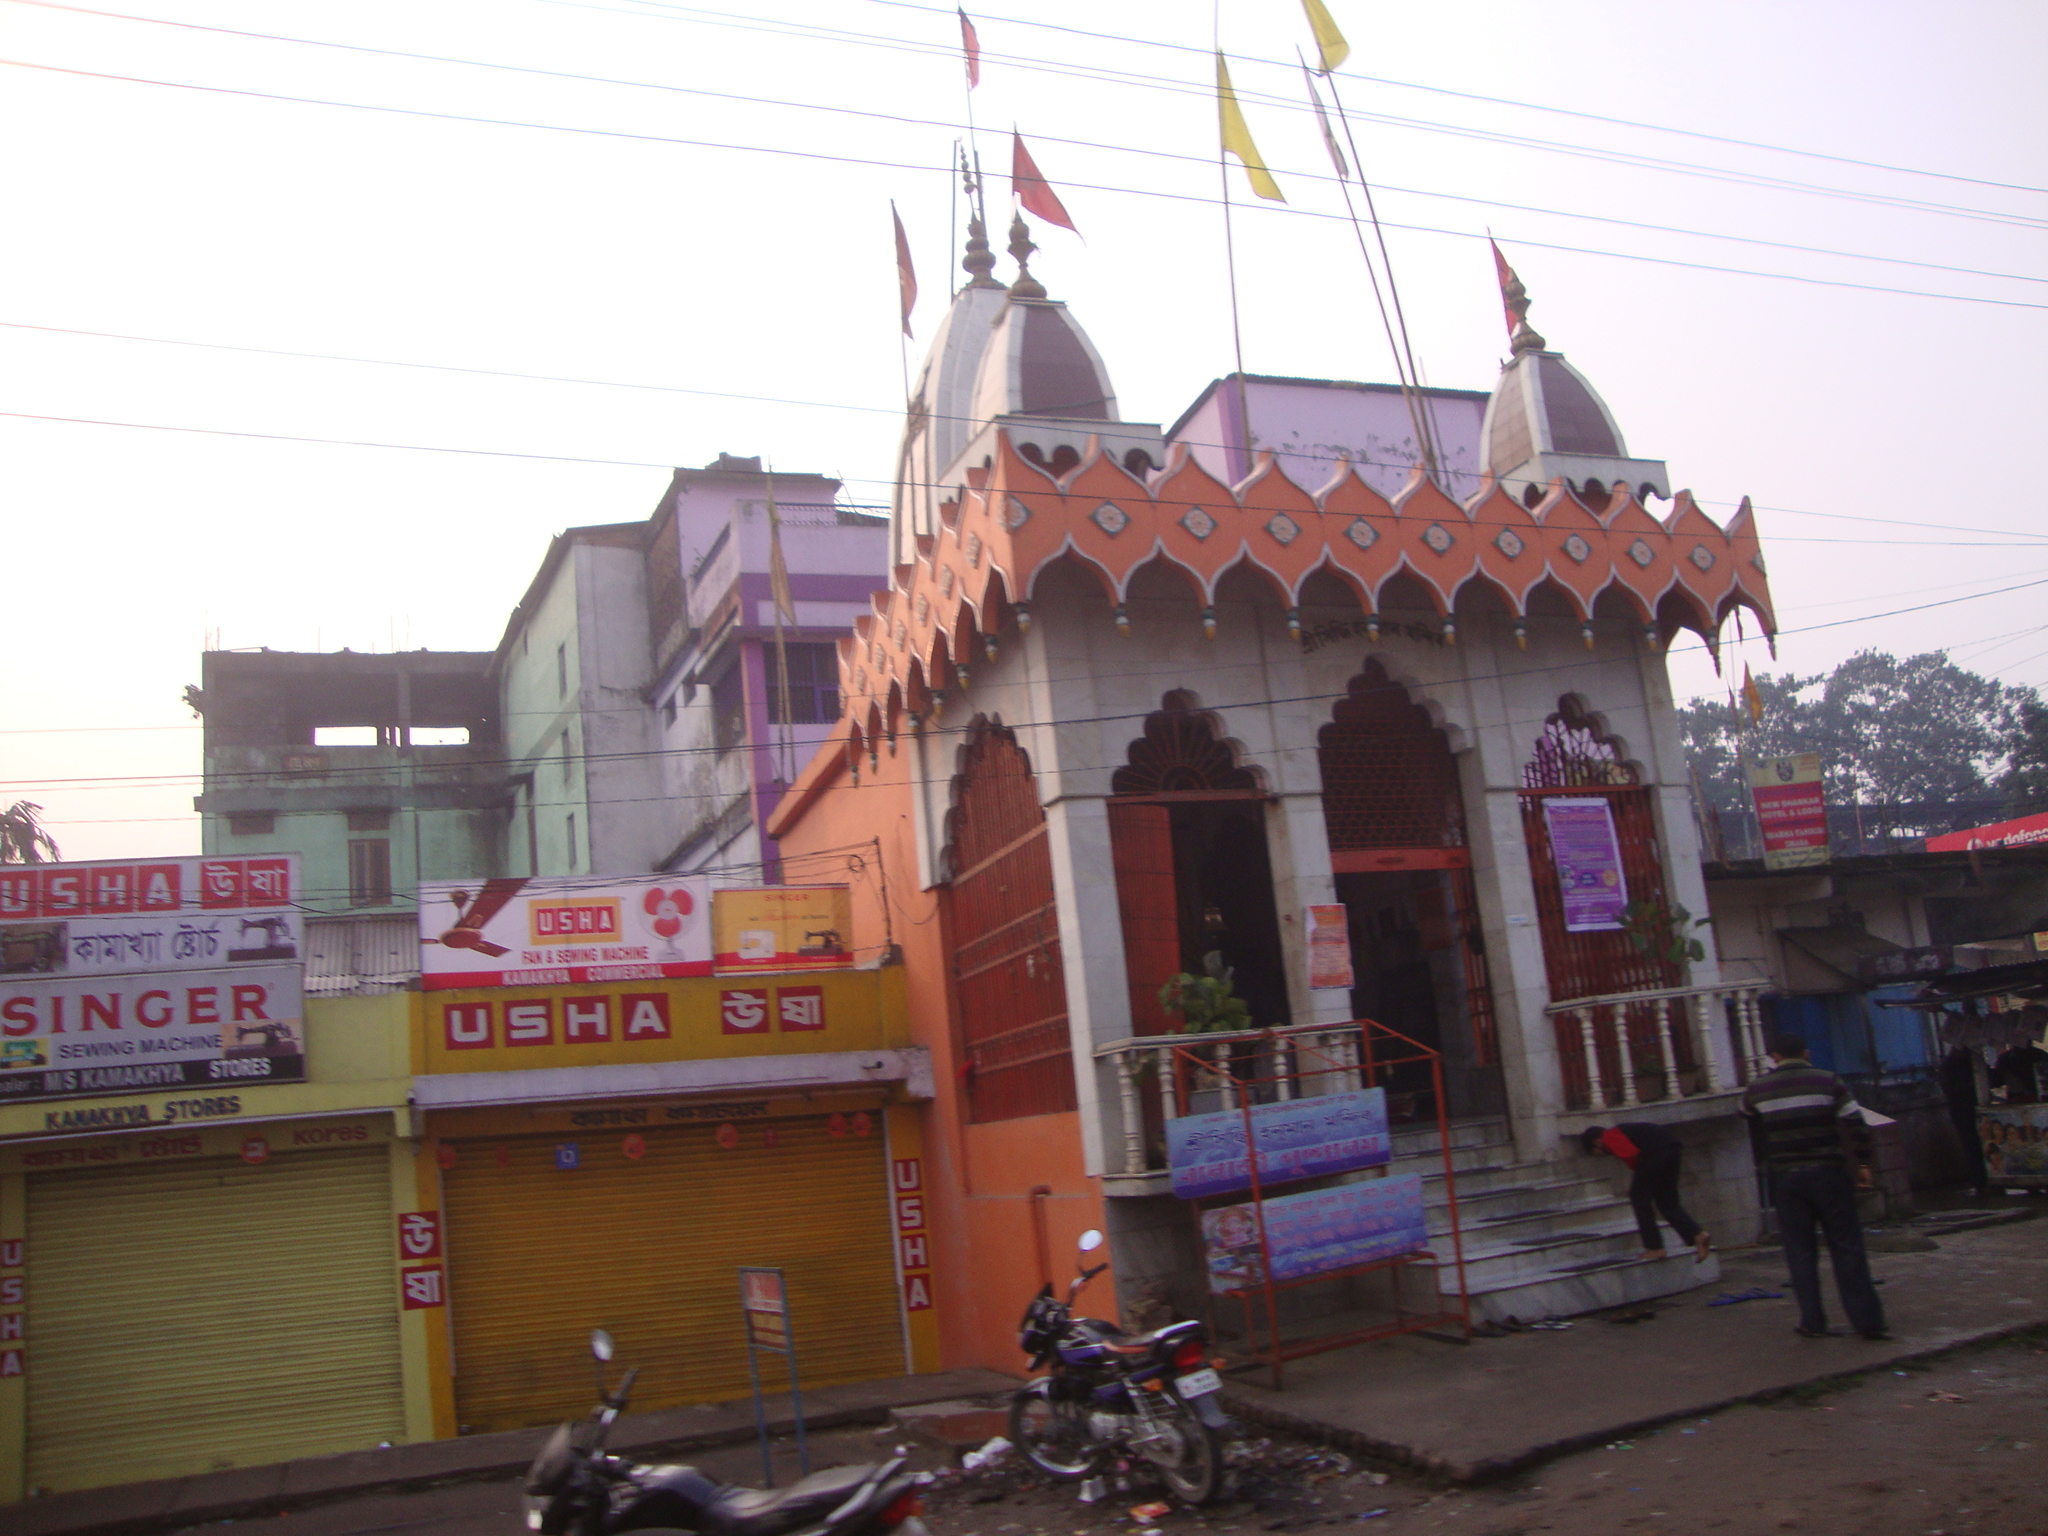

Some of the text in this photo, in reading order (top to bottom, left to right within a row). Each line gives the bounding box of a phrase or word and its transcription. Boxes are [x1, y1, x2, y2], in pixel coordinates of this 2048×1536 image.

[1, 872, 170, 912] USHA
[206, 865, 287, 898] উষা
[538, 909, 612, 932] USHA
[521, 946, 650, 965] FAN & SEWING MACHINE
[502, 964, 666, 986] KAMAKHYA COMMERCIAL
[2, 984, 270, 1037] SINGER
[450, 1000, 666, 1043] USHA
[723, 991, 821, 1029] উষা
[60, 1034, 222, 1059] SEWING MACHINE
[81, 1063, 186, 1089] KAMAKHYA
[209, 1057, 272, 1079] STORES
[46, 1095, 242, 1130] KAMAKHYA STORES
[896, 1161, 930, 1308] USHA
[402, 1214, 441, 1303] উষা
[2, 1241, 22, 1376] USHA
